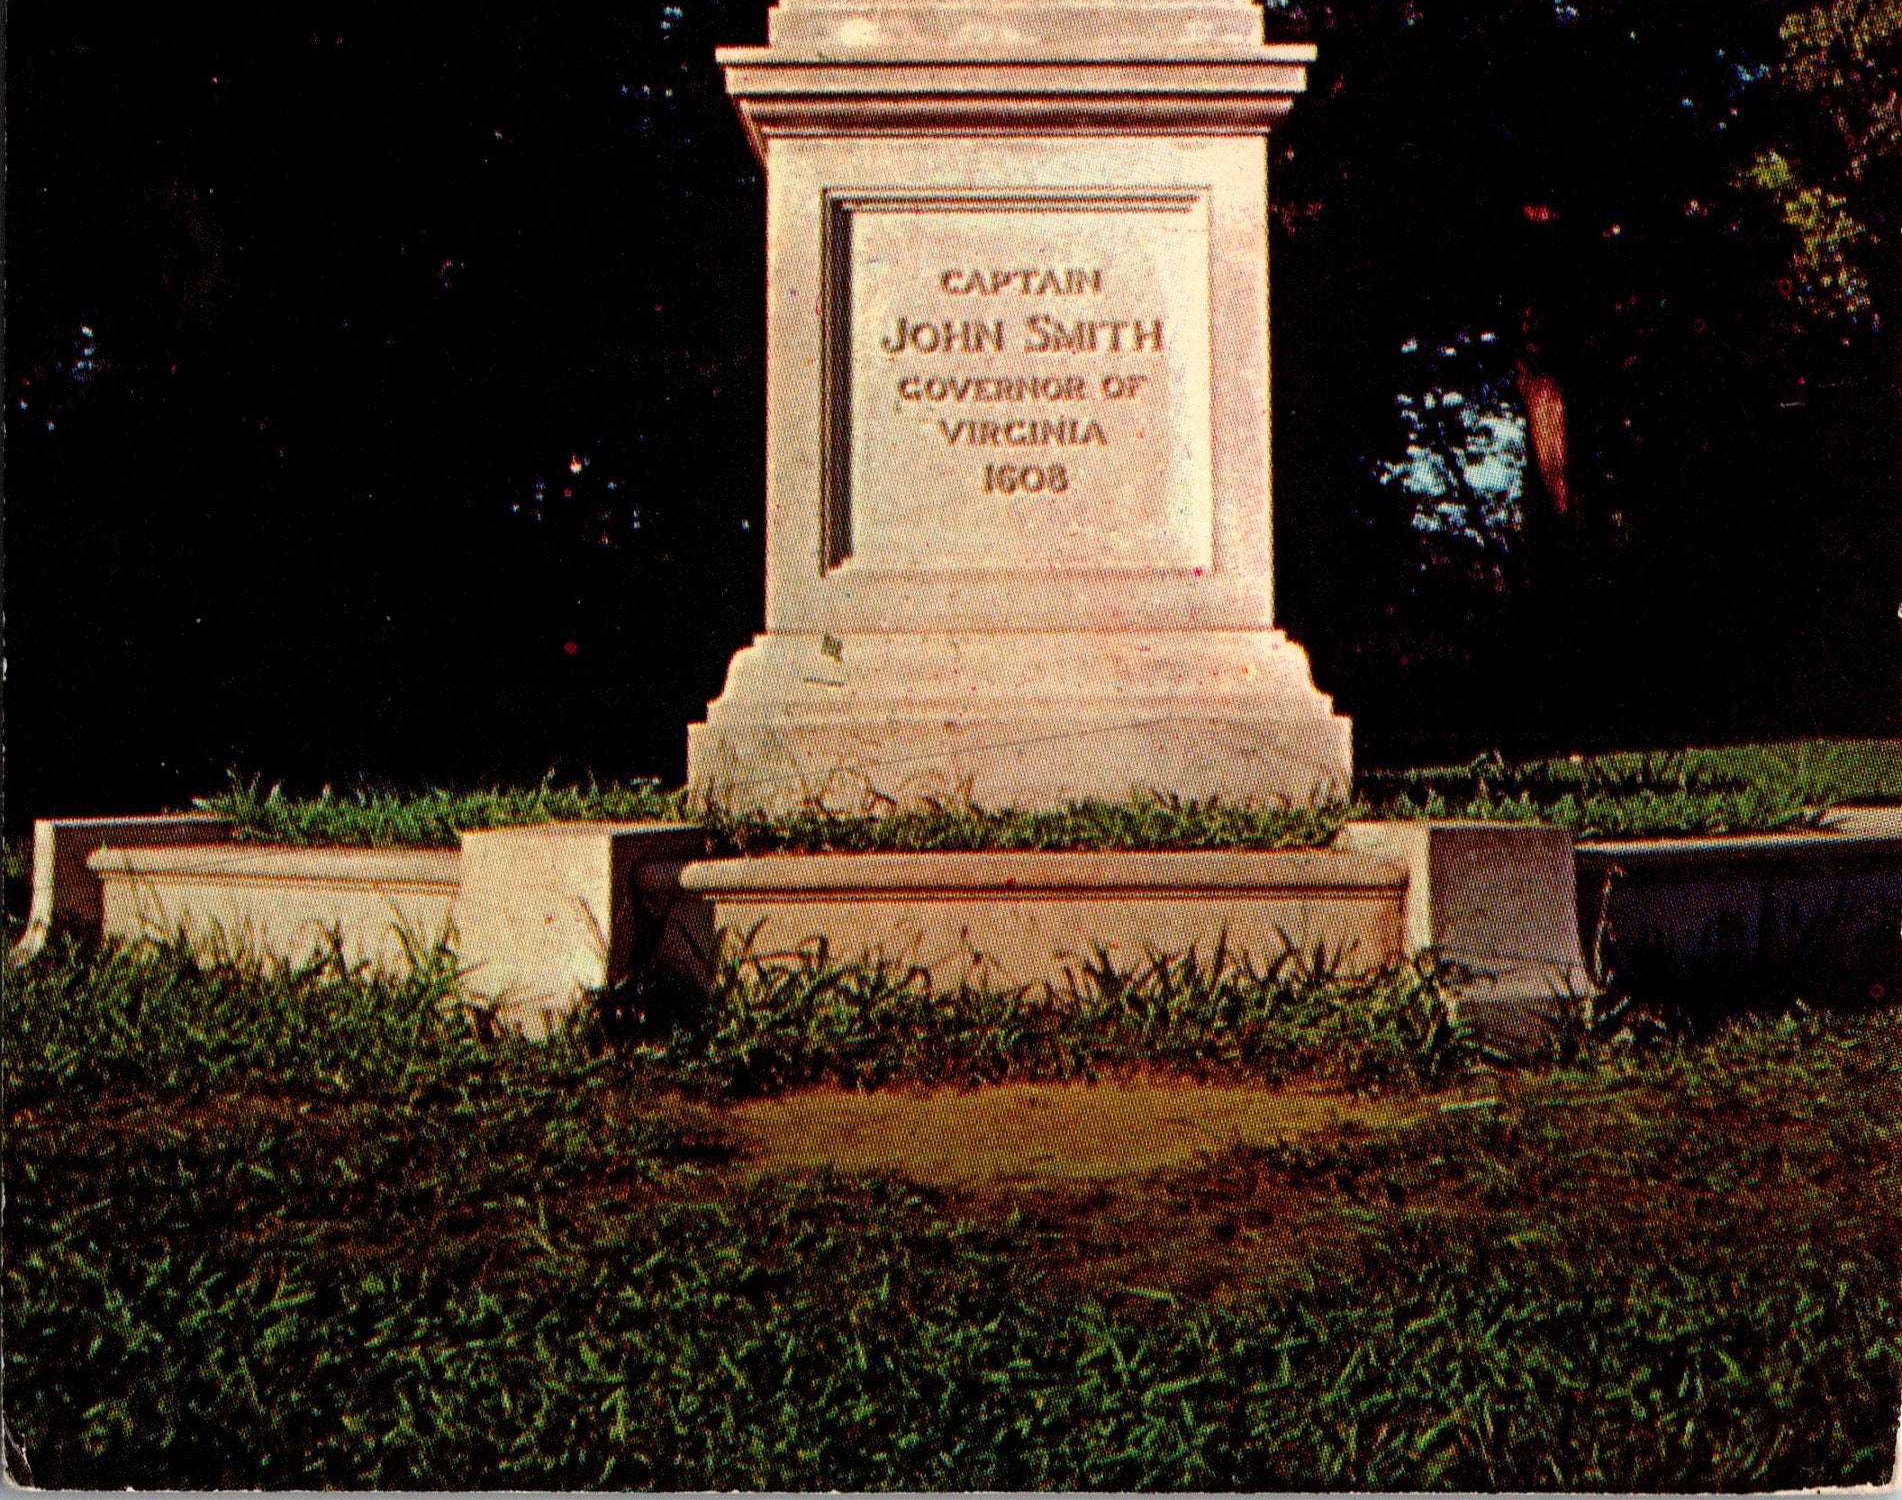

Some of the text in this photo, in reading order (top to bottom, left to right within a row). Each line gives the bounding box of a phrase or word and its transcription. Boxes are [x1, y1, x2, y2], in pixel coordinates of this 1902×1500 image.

[940, 267, 1103, 296] CAPTAIN
[881, 314, 1164, 353] JOHN SMITH
[899, 374, 1148, 402] GOVERNOR OF
[939, 418, 1108, 447] VIRGINIA
[983, 463, 1069, 495] 1608
